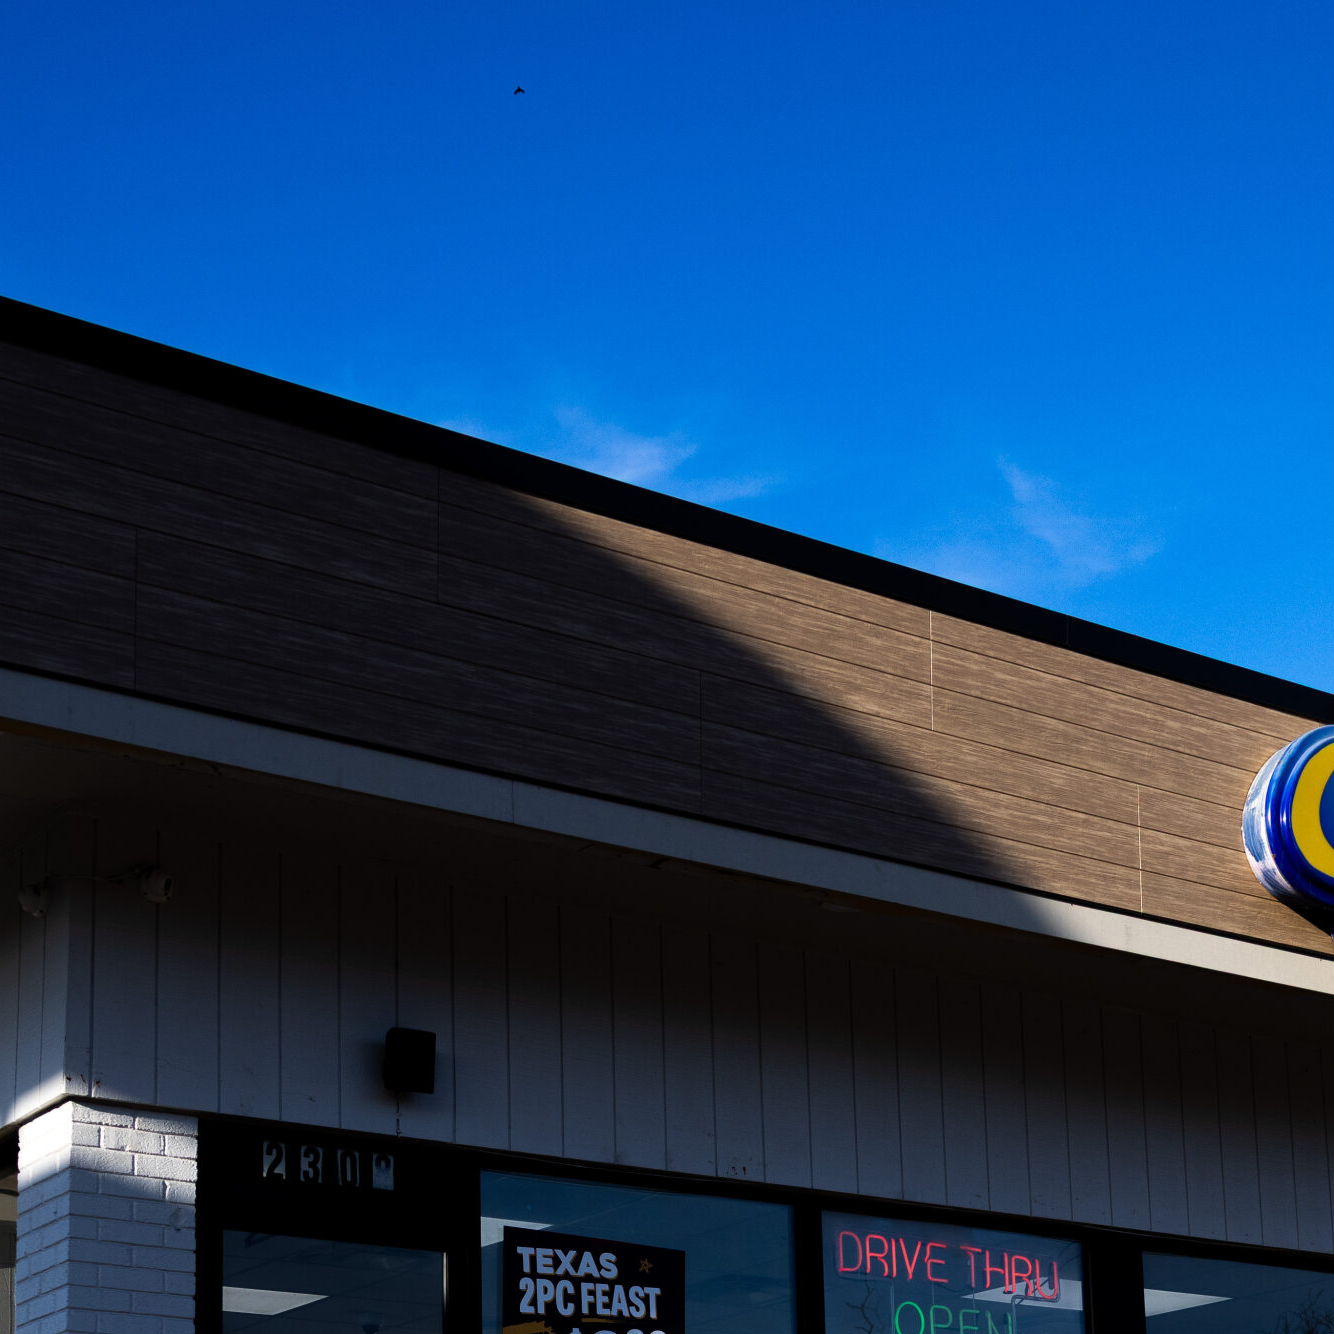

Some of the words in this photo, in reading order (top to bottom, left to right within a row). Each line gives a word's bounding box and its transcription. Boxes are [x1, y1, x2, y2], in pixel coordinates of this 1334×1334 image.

[517, 1246, 619, 1280] TEXAS
[838, 1231, 948, 1283] DRIVE
[959, 1245, 1058, 1300] THRU
[518, 1276, 575, 1318] 2PC
[580, 1282, 662, 1320] FEAST
